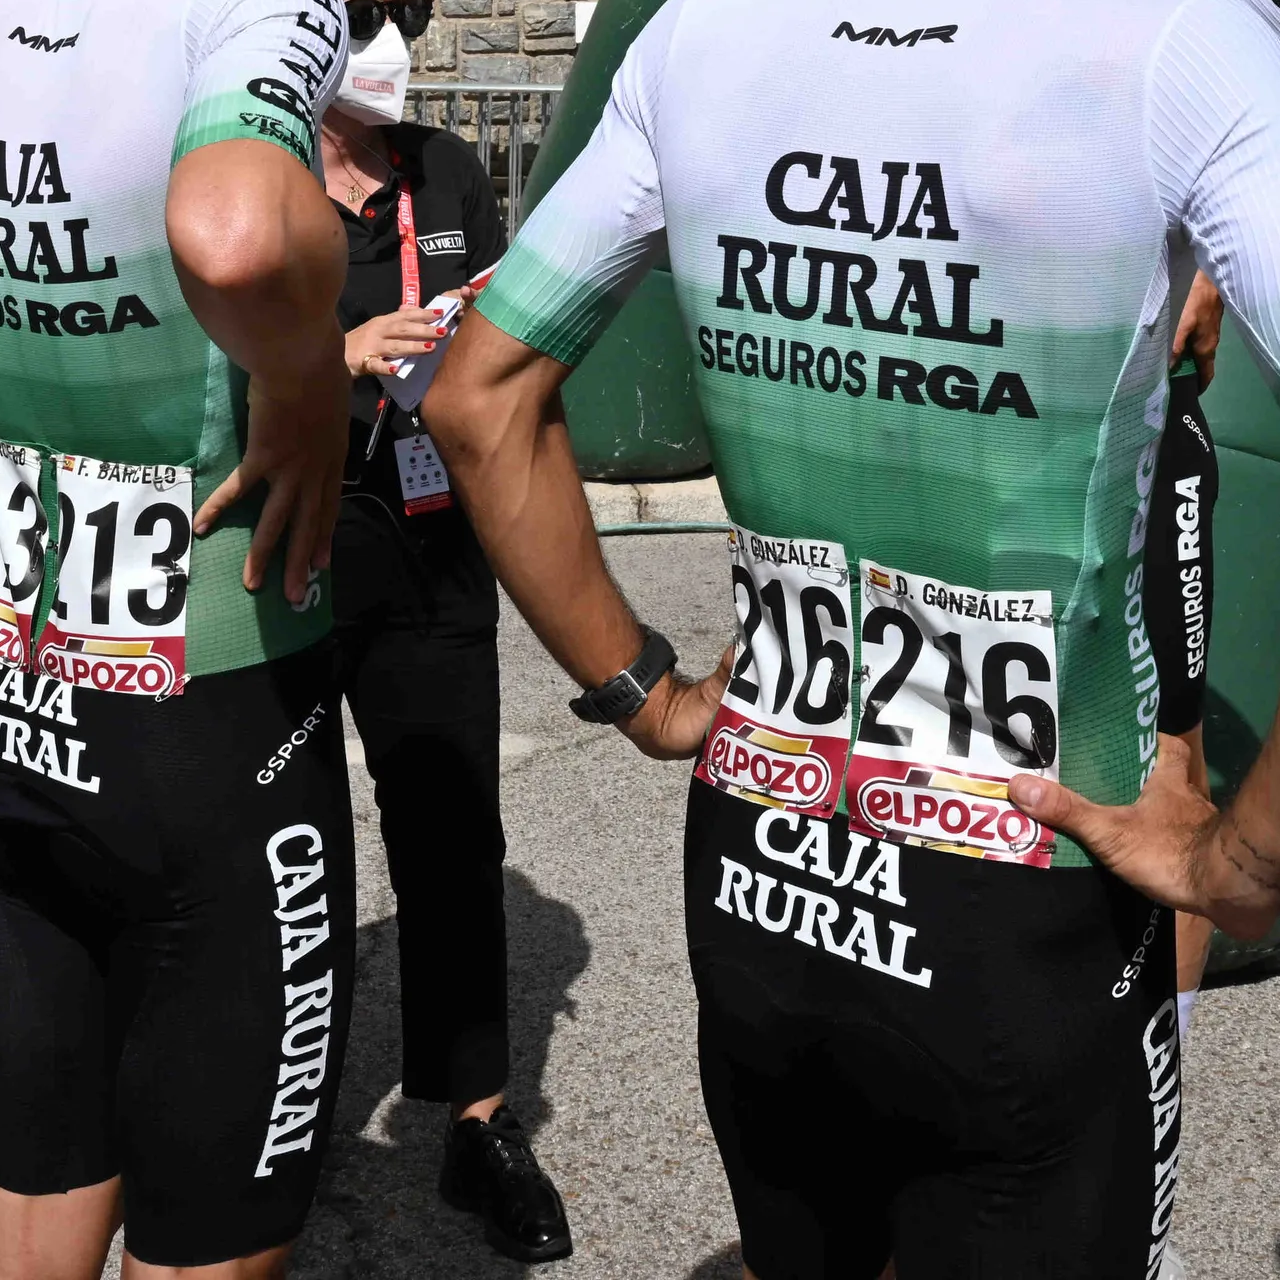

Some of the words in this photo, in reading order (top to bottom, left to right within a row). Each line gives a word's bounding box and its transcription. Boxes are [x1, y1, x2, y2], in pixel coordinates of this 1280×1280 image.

[831, 21, 958, 47] MMR
[765, 151, 958, 241] CAJA
[424, 241, 437, 251] LA
[437, 237, 463, 250] VUELTA
[28, 294, 160, 337] RGA
[716, 234, 1004, 348] RURAL
[698, 325, 867, 397] SEGUROS
[877, 356, 1040, 420] RGA
[77, 458, 90, 477] F.
[1182, 413, 1210, 453] GSPORT
[751, 537, 830, 568] GONZÁLEZ
[1174, 475, 1202, 562] RGA
[896, 574, 915, 600] D.
[923, 583, 1035, 622] GONZÁLEZ
[1180, 563, 1204, 680] SEGUROS
[727, 565, 851, 725] 216
[857, 607, 1055, 769] 216
[256, 703, 326, 785] GSPORT
[265, 824, 330, 971] CAJA
[755, 808, 907, 907] CAJA
[714, 855, 932, 989] RURAL
[1111, 904, 1162, 998] GSPOR
[253, 968, 334, 1178] RURAL
